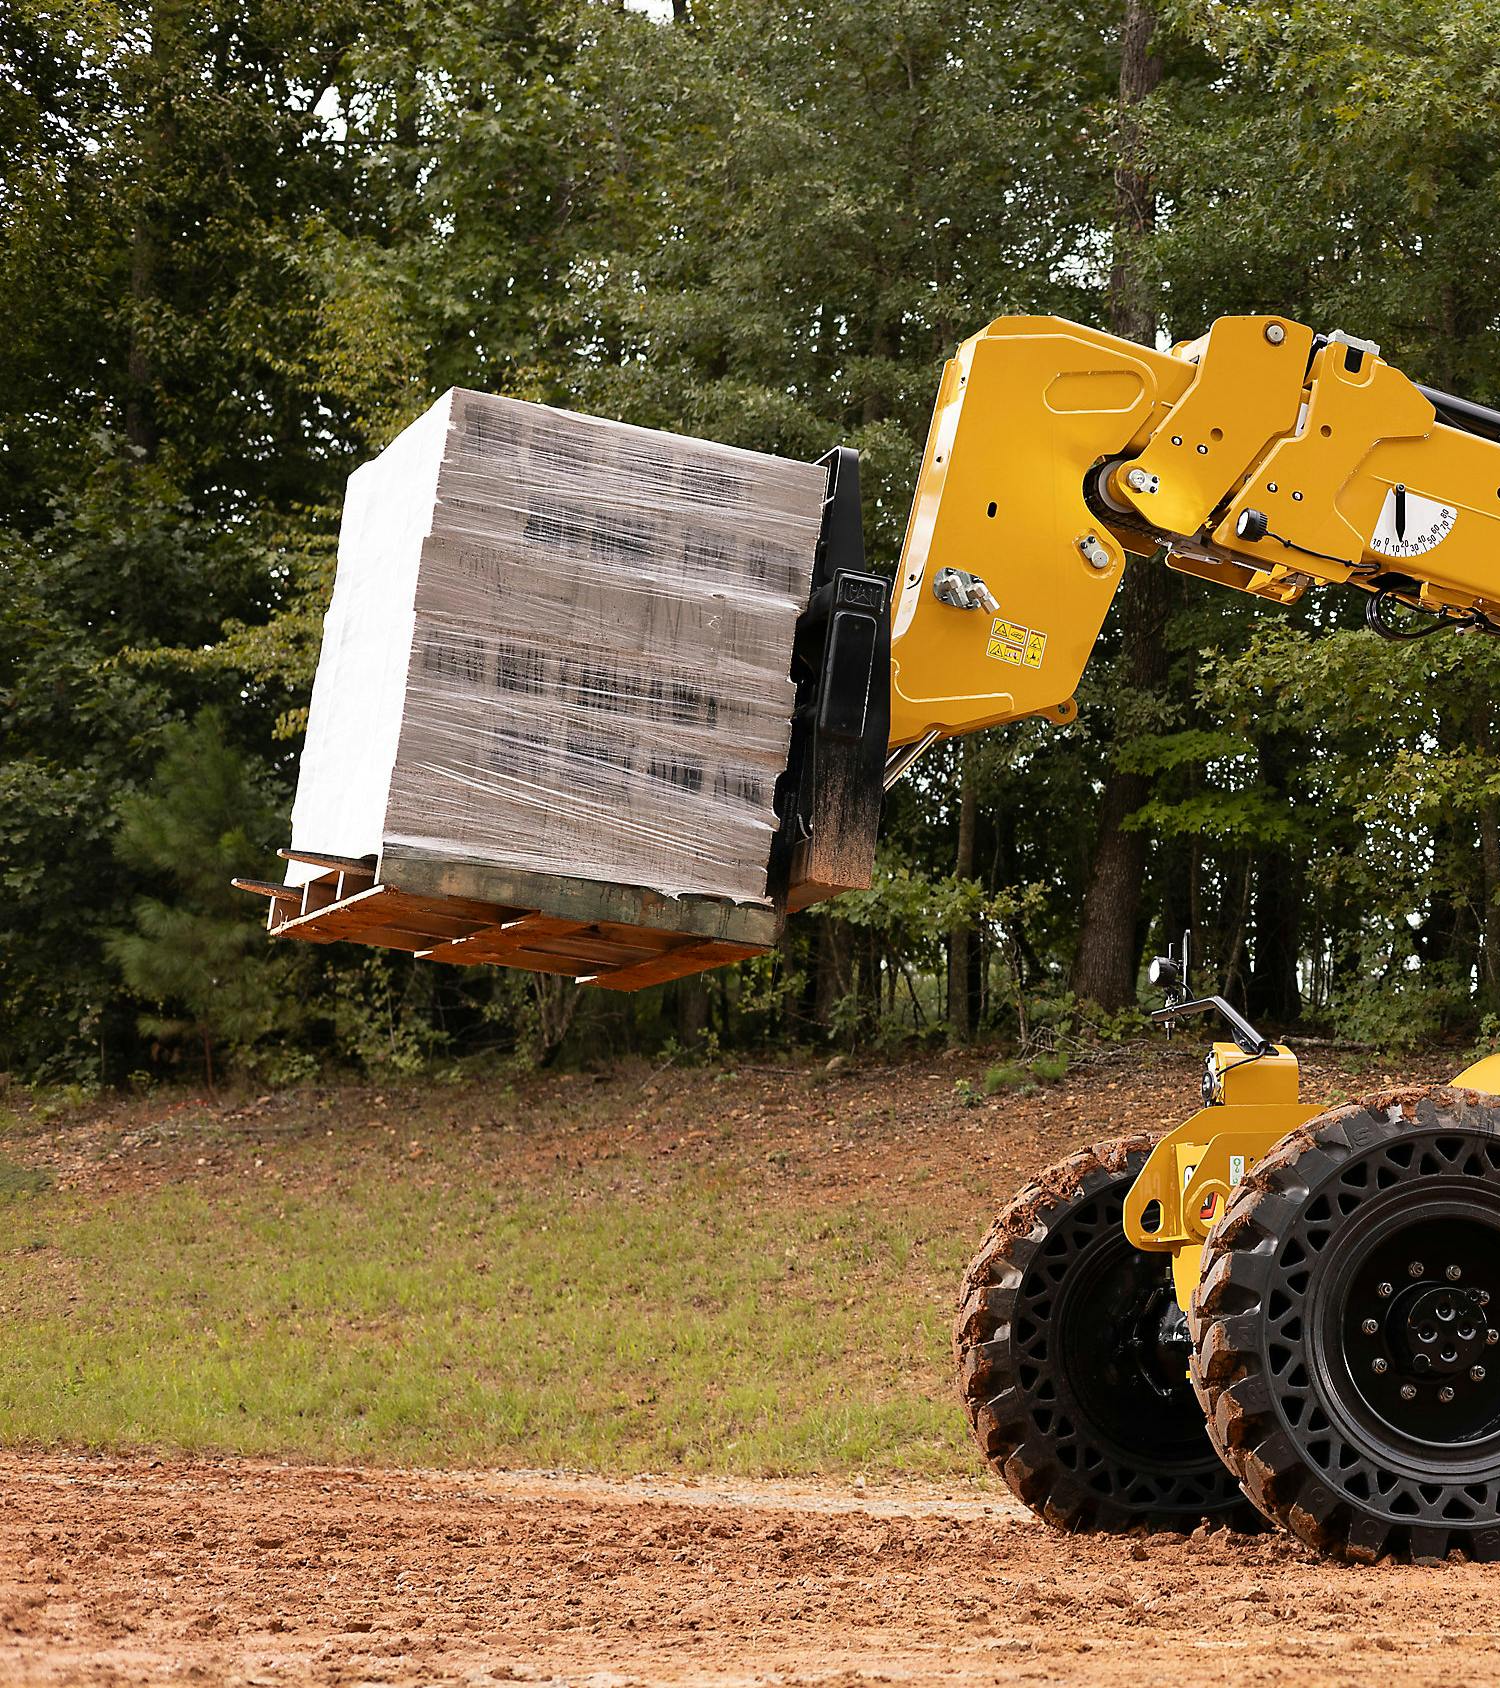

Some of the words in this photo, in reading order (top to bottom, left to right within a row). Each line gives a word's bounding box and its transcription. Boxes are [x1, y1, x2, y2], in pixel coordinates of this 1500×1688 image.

[1440, 508, 1449, 519] 80
[1430, 524, 1440, 535] 60
[1439, 520, 1449, 530] 70
[1372, 538, 1382, 548] 10
[1384, 537, 1390, 546] 0
[1400, 539, 1410, 548] 20
[1417, 534, 1427, 544] 40
[1426, 534, 1437, 544] 50
[1391, 544, 1400, 553] 10
[1409, 543, 1420, 552] 30
